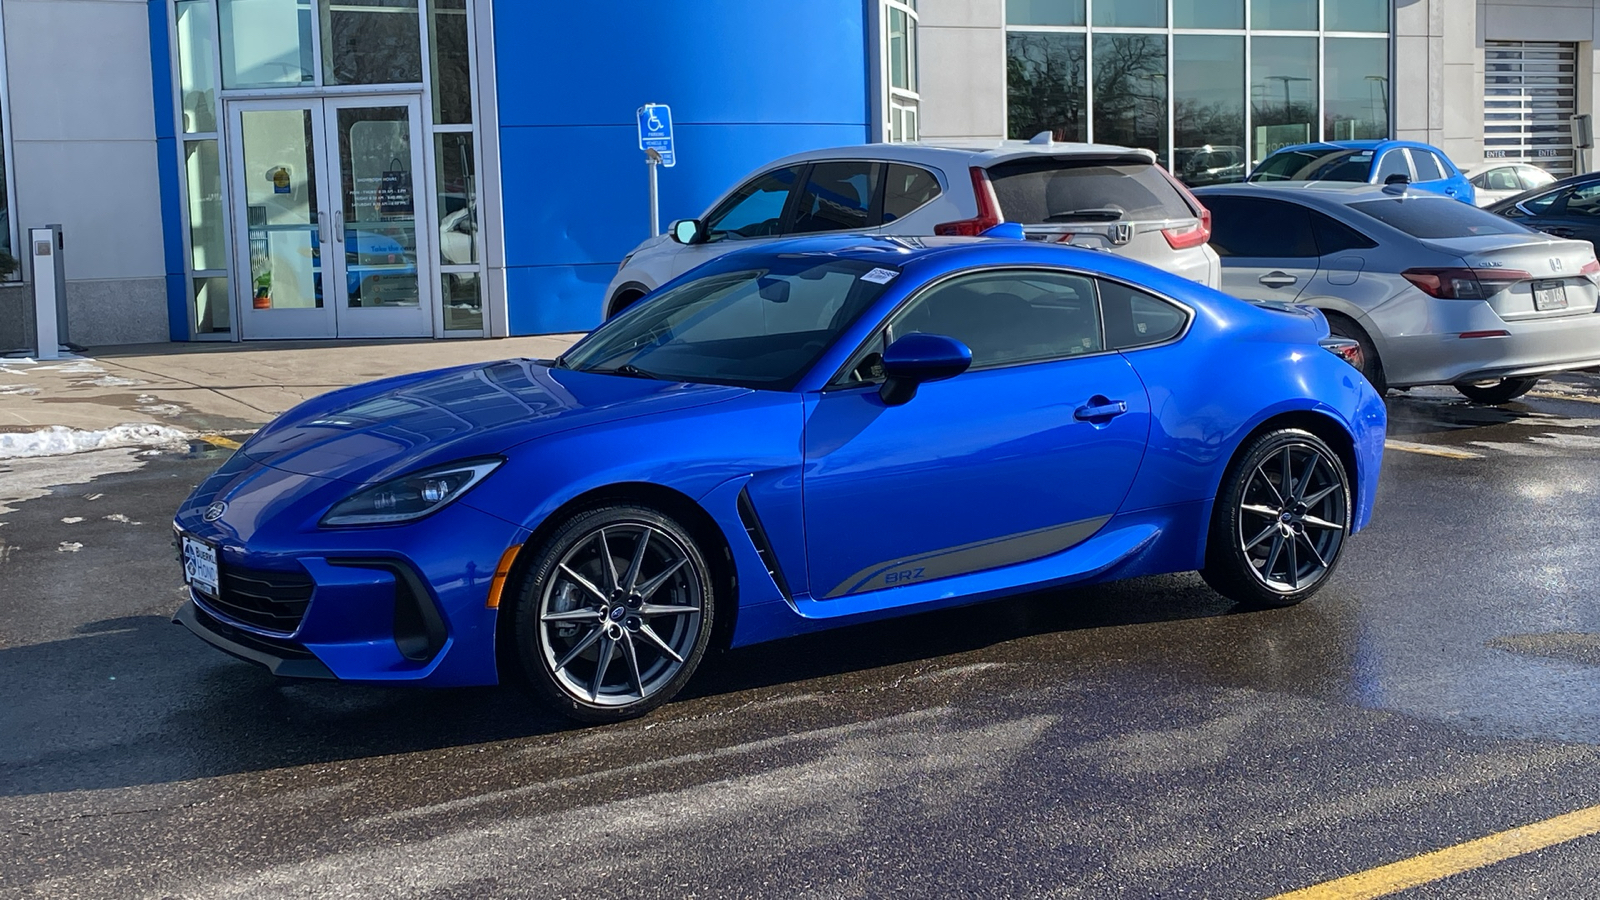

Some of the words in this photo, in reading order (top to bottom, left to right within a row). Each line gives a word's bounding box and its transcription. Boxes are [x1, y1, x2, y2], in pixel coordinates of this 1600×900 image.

[1486, 150, 1506, 158] ENTER
[1538, 149, 1558, 157] ENTER
[388, 244, 399, 252] the
[885, 567, 926, 584] BRZ
